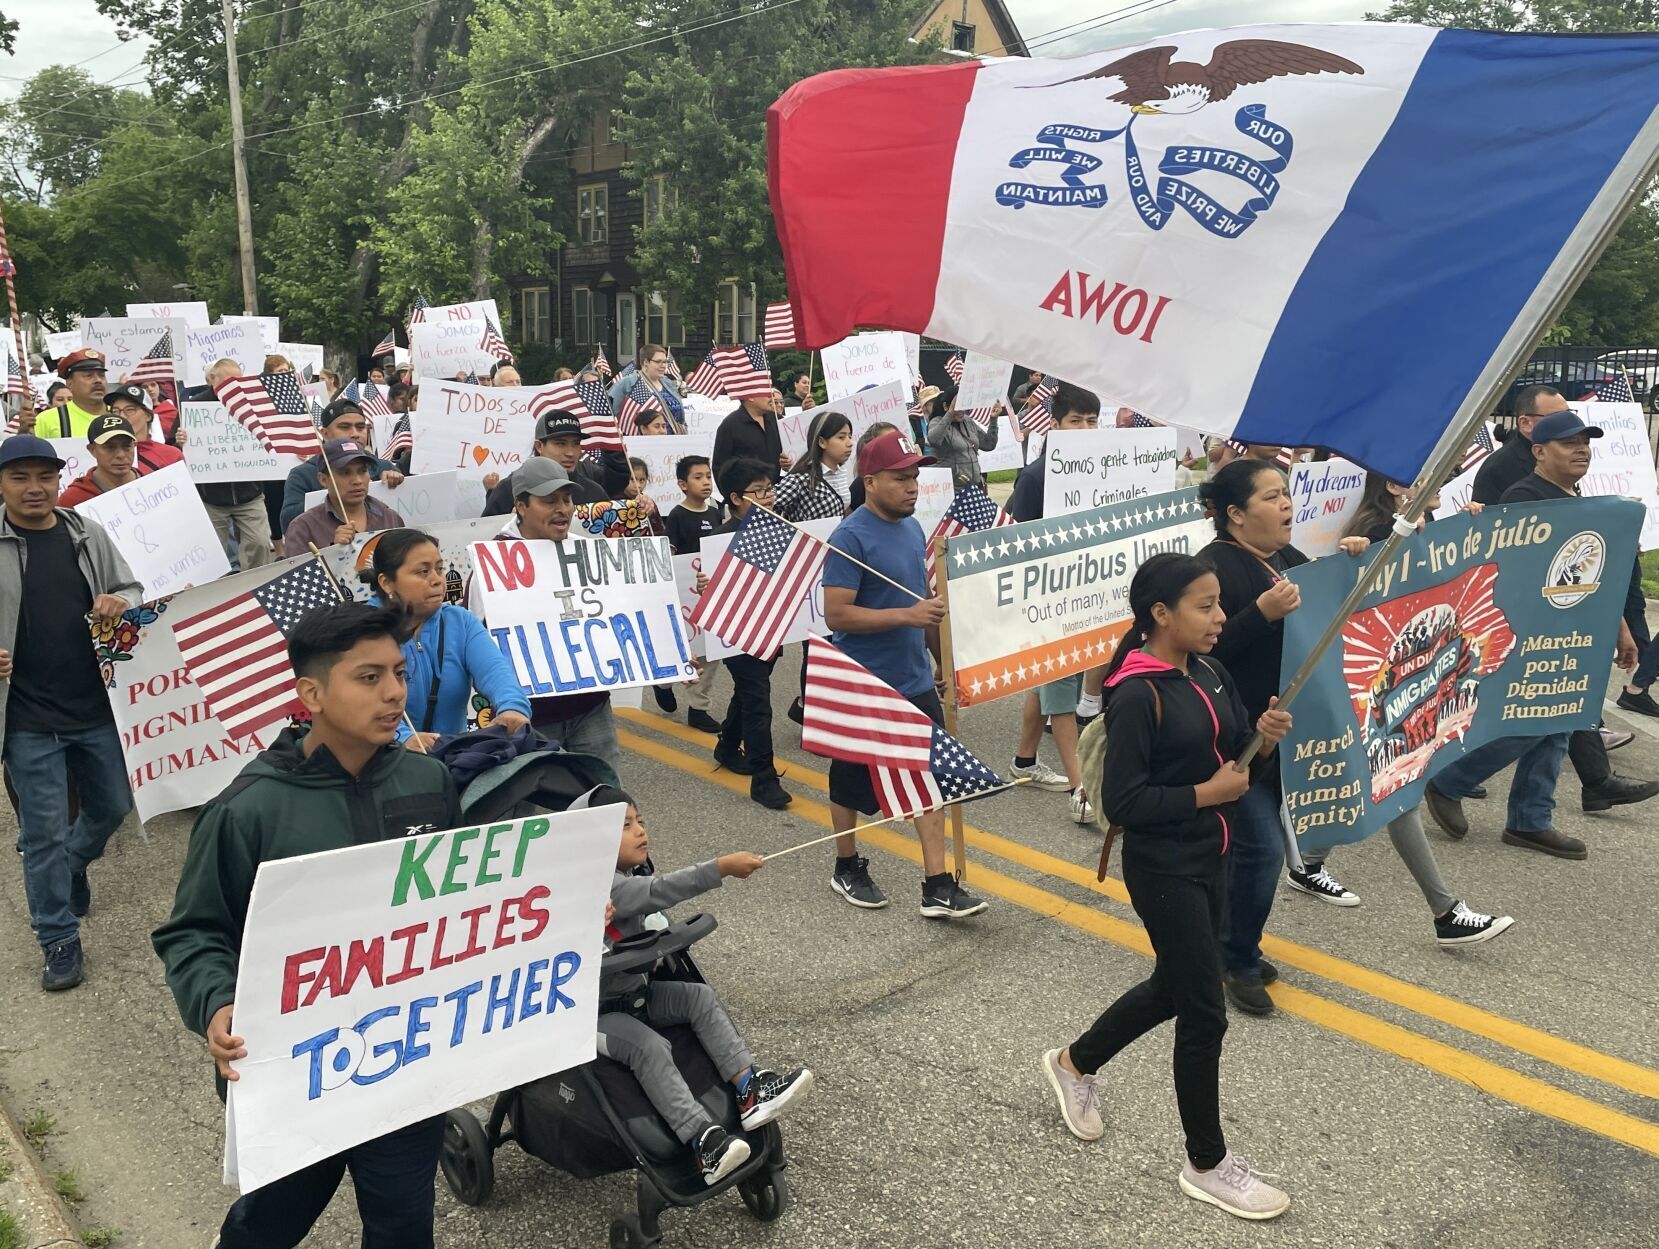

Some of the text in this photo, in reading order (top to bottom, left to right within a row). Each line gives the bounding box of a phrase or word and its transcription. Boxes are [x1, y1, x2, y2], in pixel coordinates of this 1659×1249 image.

[447, 305, 472, 321] NO
[113, 337, 131, 352] &
[187, 325, 245, 353] Migramos
[225, 347, 238, 358] un
[110, 358, 132, 368] nos
[844, 360, 875, 377] fuerza
[882, 357, 897, 370] de
[102, 416, 124, 429] P
[225, 423, 247, 436] POR
[483, 416, 509, 435] DE
[189, 436, 203, 447] LA
[208, 443, 265, 456] POR LA PA
[1610, 434, 1642, 458] estar
[190, 459, 278, 473] POR LA DIGNIDAD
[1050, 447, 1095, 475] Somos
[1100, 447, 1129, 480] gente
[1064, 483, 1148, 508] NO Criminales
[1292, 465, 1363, 508] My dreams
[396, 488, 432, 517] NO
[1295, 496, 1348, 524] are NOT
[133, 523, 160, 554] &
[1462, 527, 1483, 561] de
[1484, 515, 1552, 559] julio
[475, 537, 675, 592] NO HUMAN
[997, 571, 1014, 608] E
[1023, 551, 1127, 601] Pluribus
[553, 588, 604, 621] IS
[1055, 596, 1068, 617] of
[1071, 590, 1109, 613] many,
[1112, 584, 1130, 602] we
[1092, 614, 1103, 626] the
[1104, 606, 1125, 621] United
[490, 604, 695, 696] ILLEGAL!
[1520, 630, 1593, 657] ¡Marcha
[1400, 659, 1415, 677] UN
[1523, 653, 1578, 678] por la
[128, 666, 193, 706] POR
[1506, 674, 1589, 700] Dignidad
[1501, 697, 1585, 721] Humana!
[1293, 724, 1354, 762] March
[131, 731, 268, 793] HUMANA
[1307, 759, 1346, 781] for
[1286, 779, 1362, 811] Human
[1291, 796, 1365, 836] ignity!
[390, 818, 551, 907] KEEP
[280, 885, 552, 1015] FAMILIES
[292, 951, 582, 1101] TOGETHER
